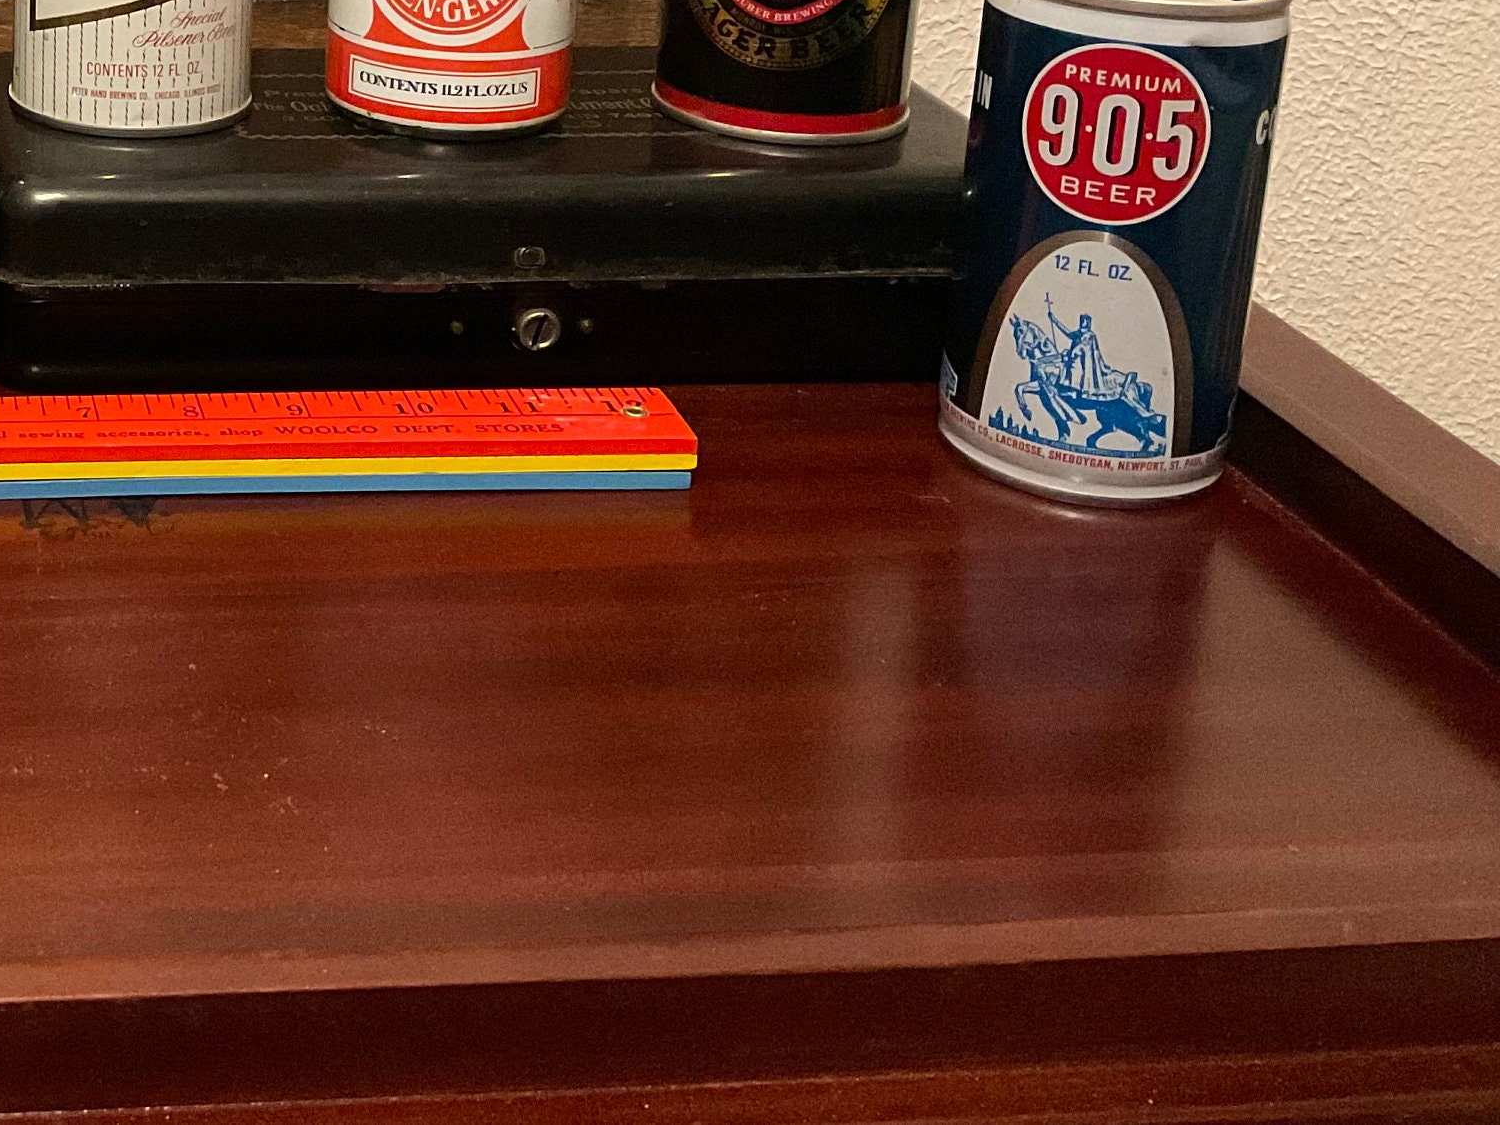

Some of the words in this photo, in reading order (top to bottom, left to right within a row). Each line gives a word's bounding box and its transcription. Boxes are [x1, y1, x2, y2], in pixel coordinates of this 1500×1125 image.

[169, 7, 227, 30] Special
[132, 29, 206, 48] Pilsener
[86, 61, 148, 78] CONTENTS
[151, 63, 164, 78] 12
[1064, 62, 1183, 95] PREMIUM
[71, 85, 89, 97] PETER
[90, 88, 108, 99] HAND
[109, 89, 137, 101] BREWING
[154, 90, 181, 101] CHICAGO
[359, 69, 438, 95] CONTENTS
[1059, 174, 1158, 207] BEER
[1053, 254, 1071, 272] 12
[74, 406, 93, 420] 7
[181, 404, 200, 419] 8
[285, 402, 303, 417] 9
[394, 401, 435, 416] 10
[499, 399, 539, 415] 11
[18, 430, 85, 443] sewing
[96, 427, 210, 440] accessories,
[218, 427, 264, 439] shop
[274, 423, 379, 437] WOOLCO
[394, 422, 463, 435] DEPT.
[474, 421, 566, 435] STORES
[995, 433, 1046, 461] LACROSSE,
[1047, 448, 1114, 472] SHEBOYGAN,
[1117, 457, 1168, 473] NEWPORT,
[1169, 460, 1182, 472] ST.
